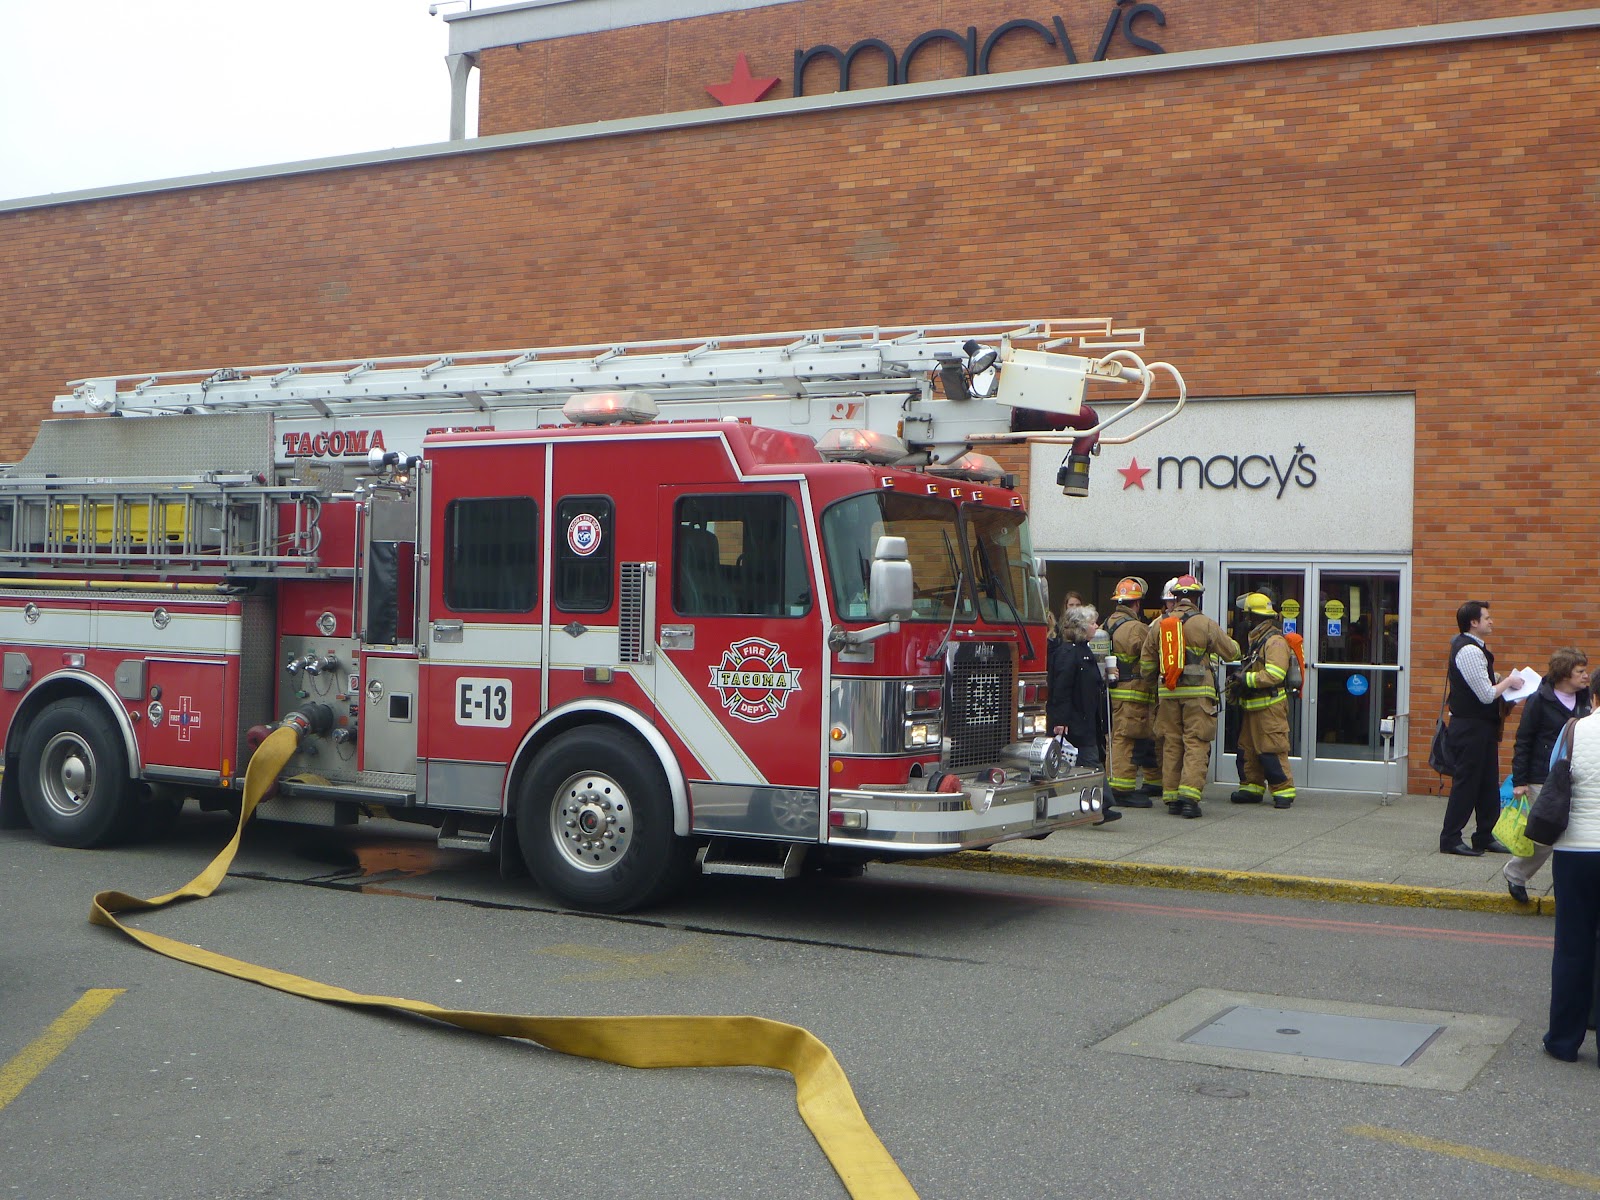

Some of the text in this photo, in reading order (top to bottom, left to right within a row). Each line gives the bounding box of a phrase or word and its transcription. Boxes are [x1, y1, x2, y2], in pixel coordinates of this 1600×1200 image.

[794, 0, 1166, 98] macys
[283, 429, 387, 458] TACOMA
[1157, 442, 1317, 500] macy's
[743, 646, 766, 656] FIRE
[1165, 631, 1175, 666] RIC
[721, 673, 787, 687] TACOMA
[461, 684, 507, 721] E-13
[741, 703, 767, 714] DEPT.
